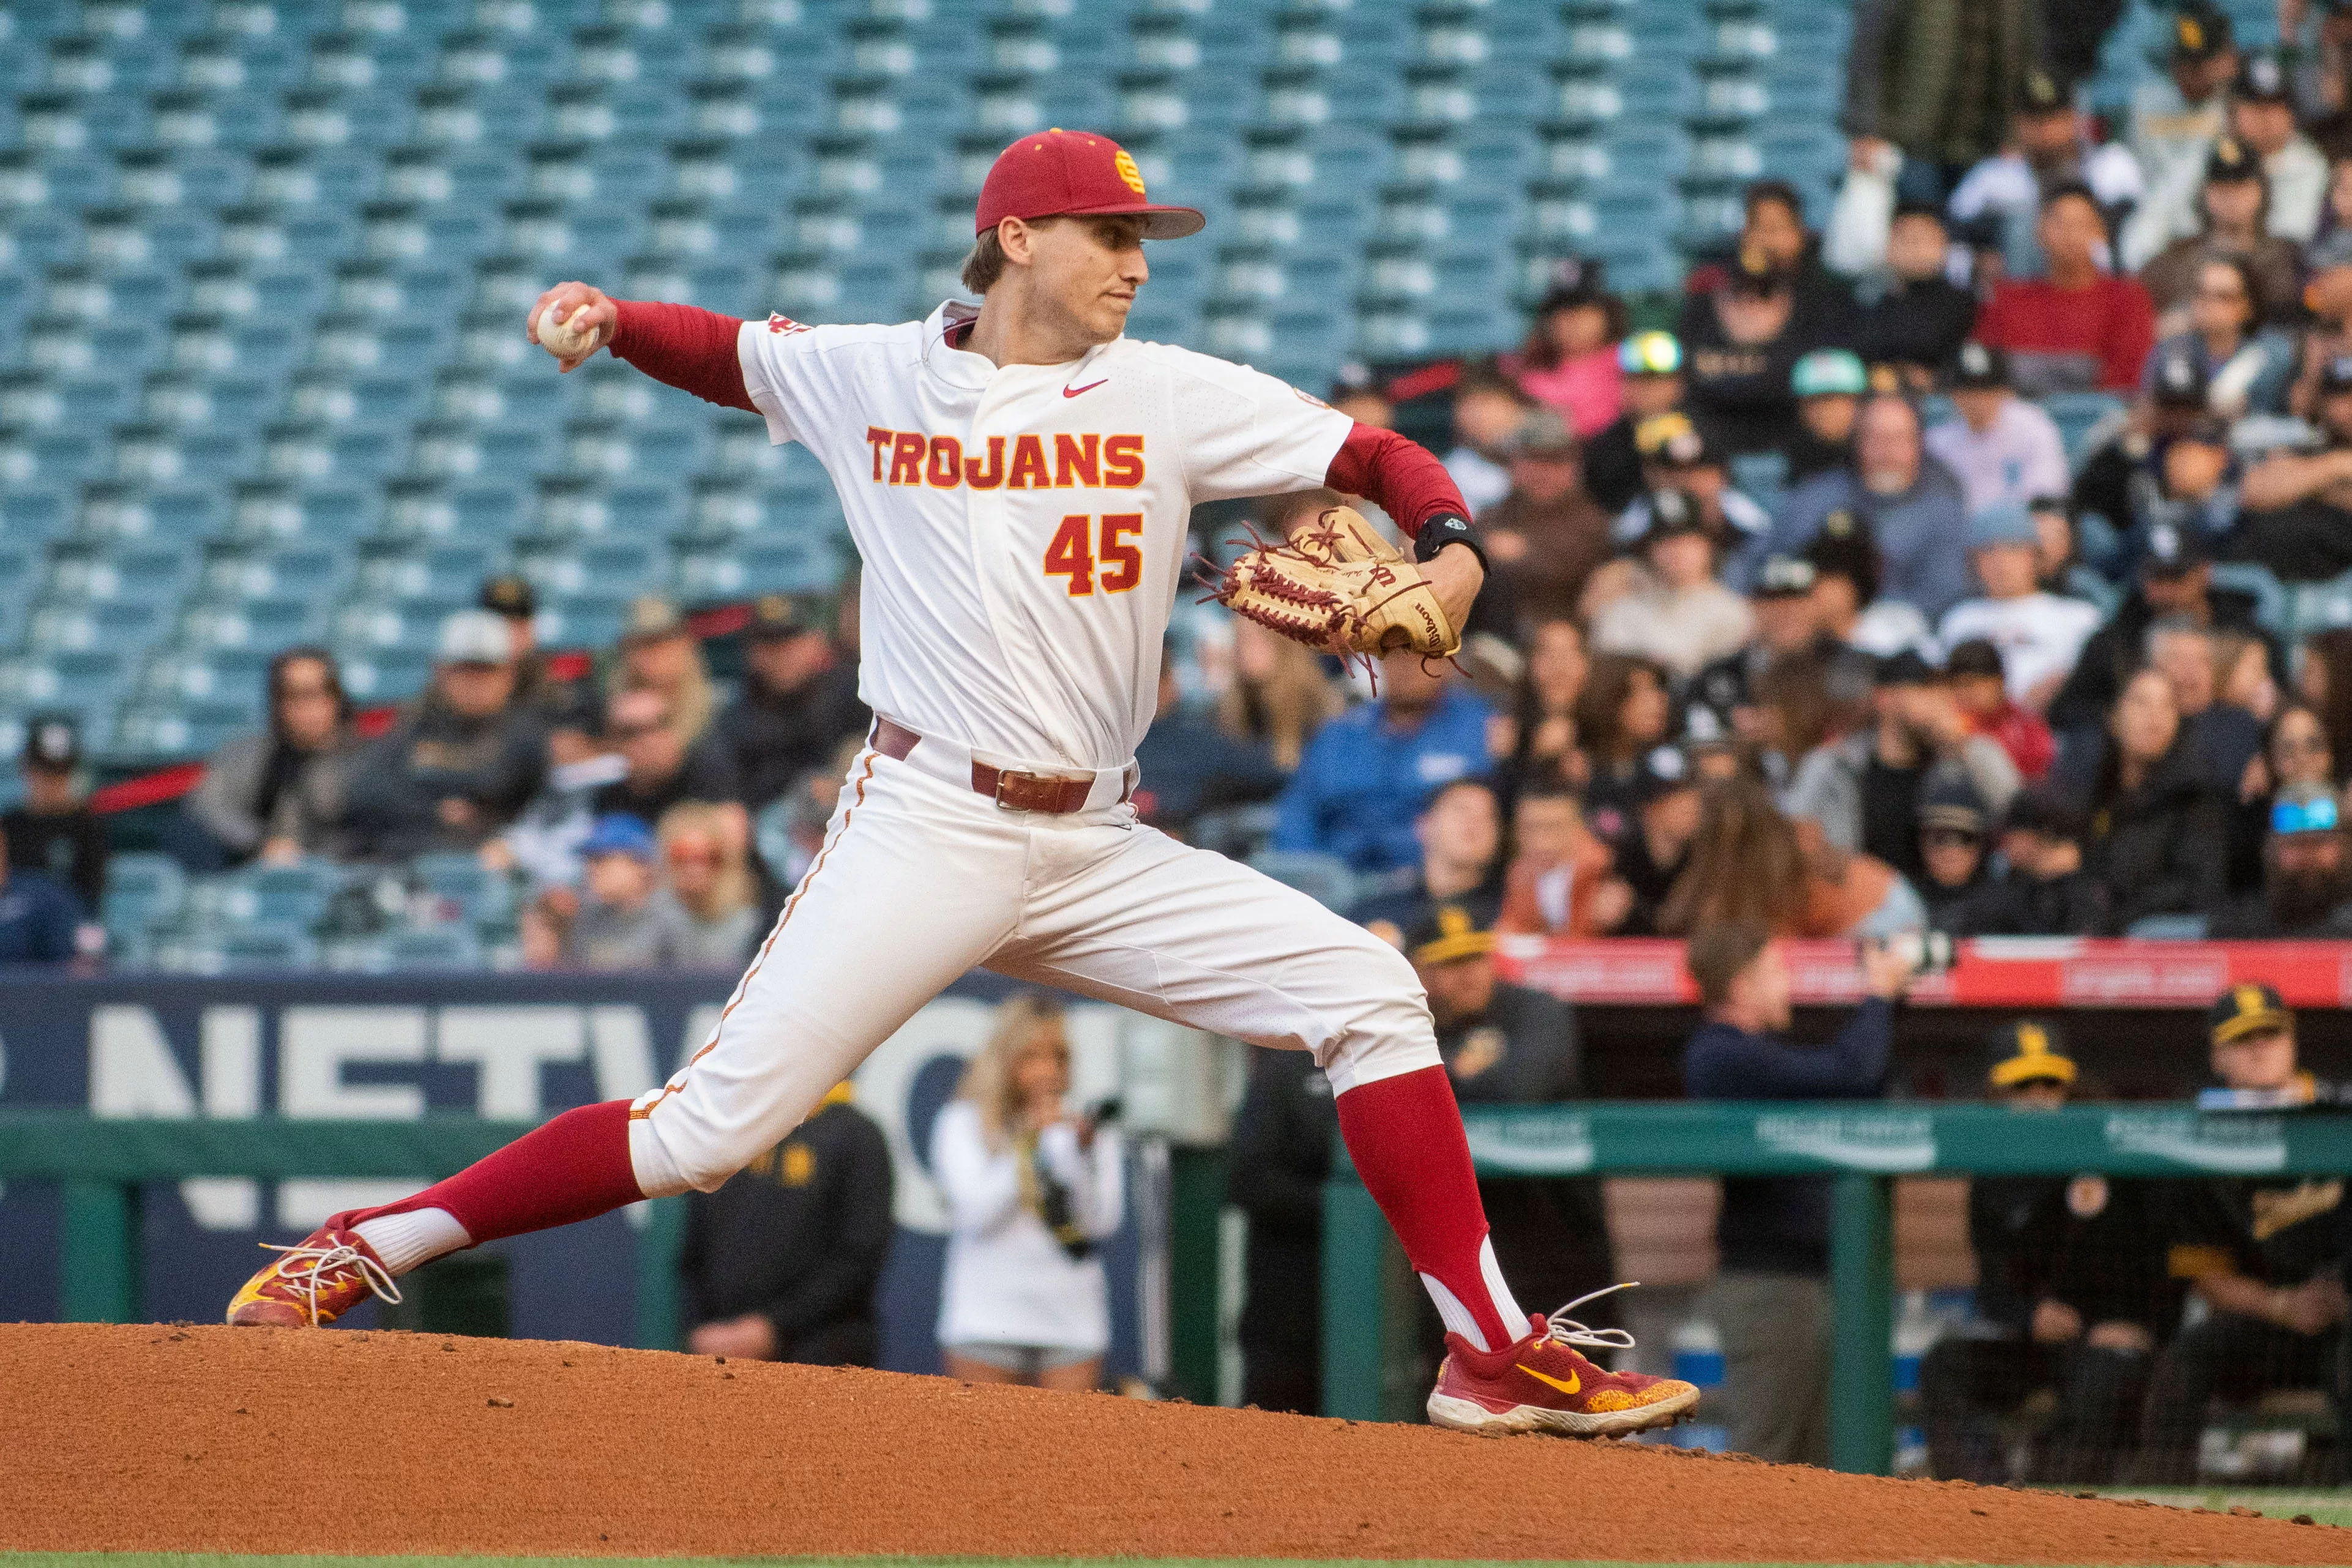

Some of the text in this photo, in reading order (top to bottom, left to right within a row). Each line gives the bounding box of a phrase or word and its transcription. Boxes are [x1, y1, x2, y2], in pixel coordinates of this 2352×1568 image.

[867, 426, 1145, 490] TROJANS
[1043, 513, 1144, 597] 45
[1415, 602, 1441, 648] Wilson
